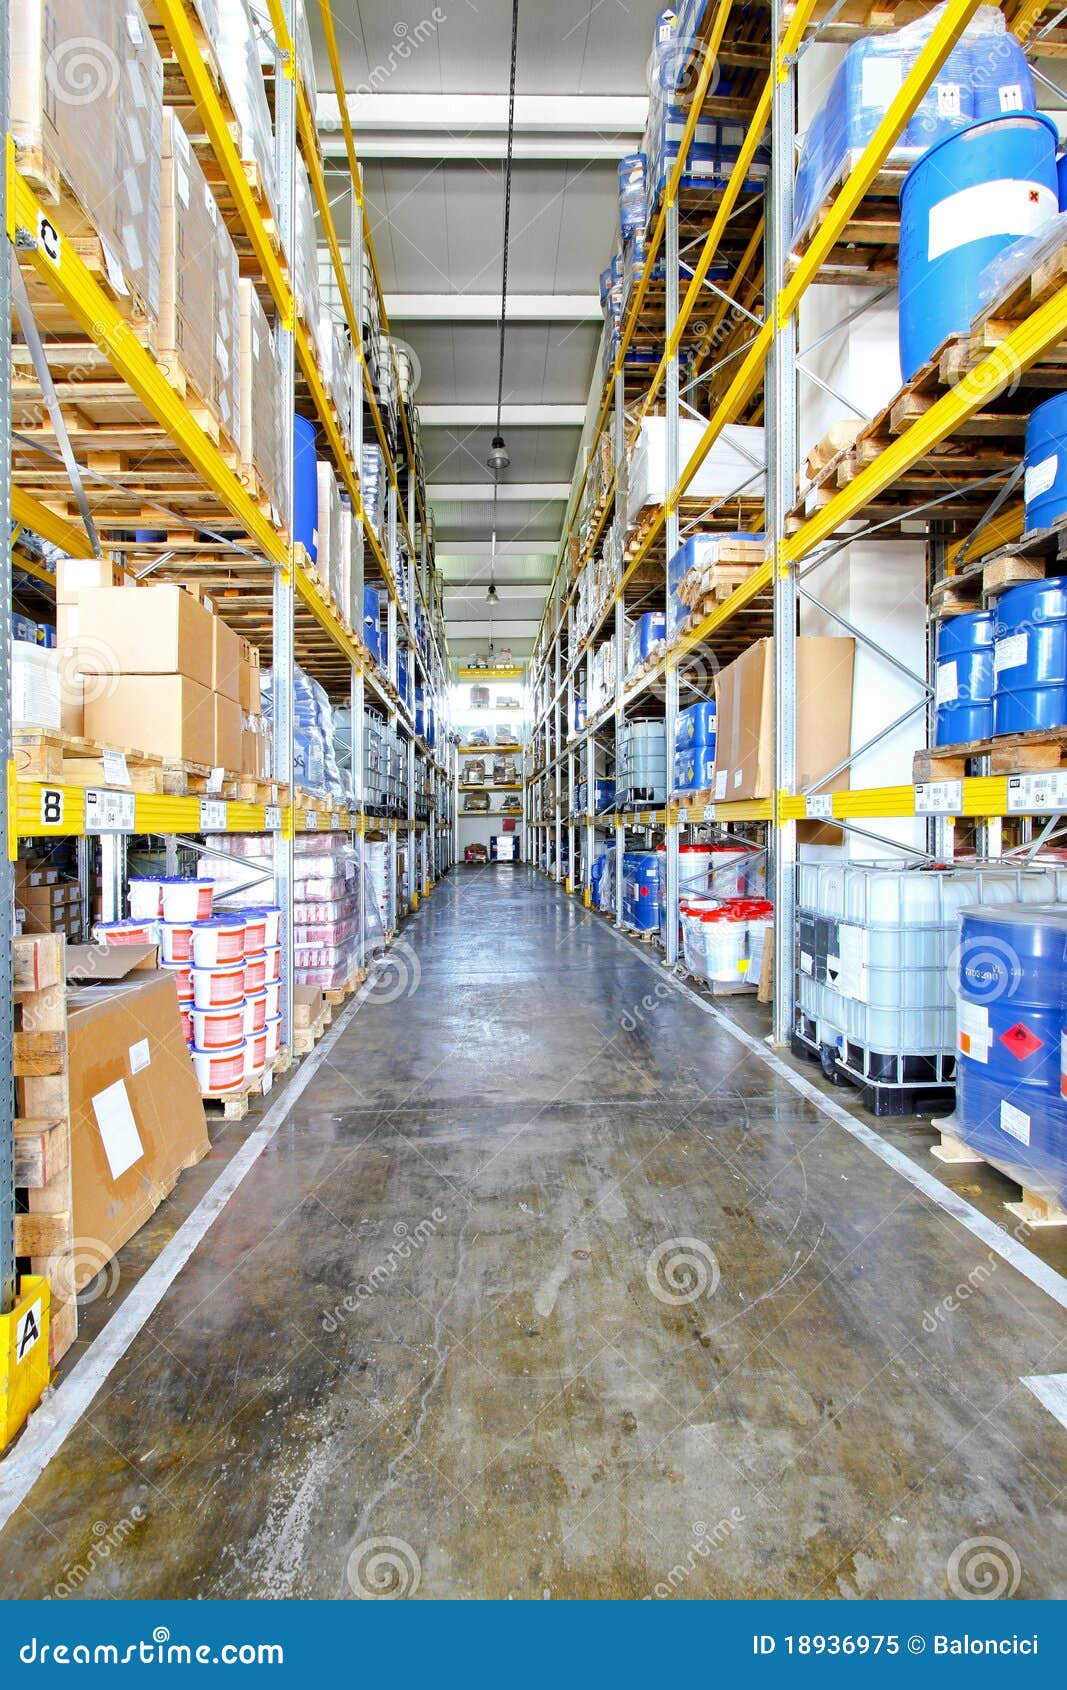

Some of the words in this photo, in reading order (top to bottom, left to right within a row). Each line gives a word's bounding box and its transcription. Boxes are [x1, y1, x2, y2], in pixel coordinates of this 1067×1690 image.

[41, 219, 58, 259] C
[44, 790, 61, 822] B
[1035, 793, 1044, 802] 04
[19, 1309, 39, 1359] A
